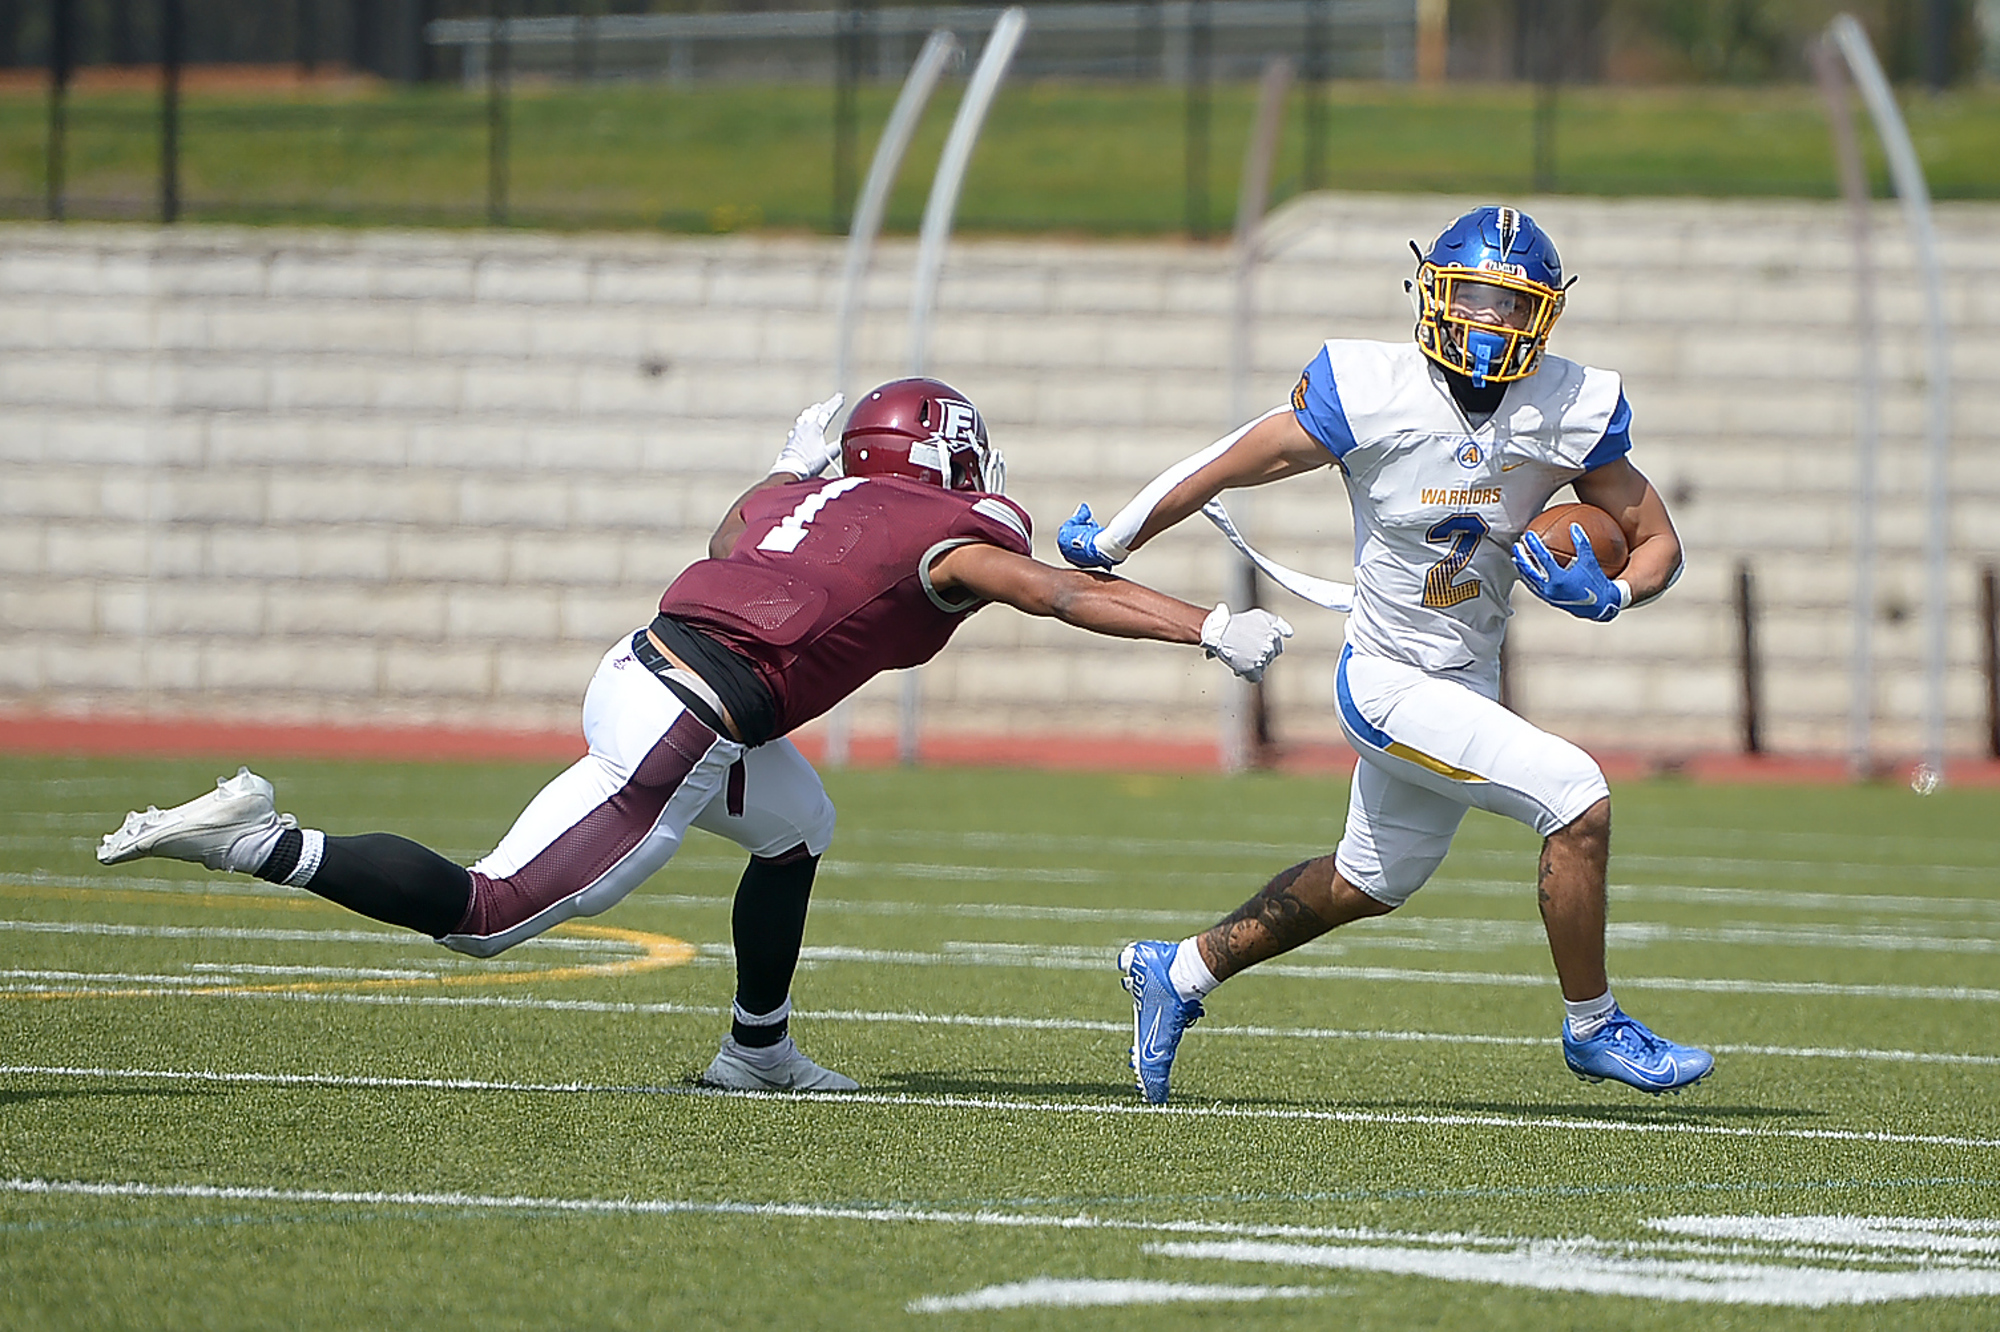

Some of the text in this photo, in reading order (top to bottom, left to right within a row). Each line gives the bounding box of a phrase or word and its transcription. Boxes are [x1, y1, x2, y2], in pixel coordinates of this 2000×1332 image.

[943, 401, 975, 440] F
[1461, 446, 1479, 464] A
[756, 476, 871, 553] 1
[1420, 487, 1502, 506] WARRIORS
[1421, 512, 1491, 607] 2
